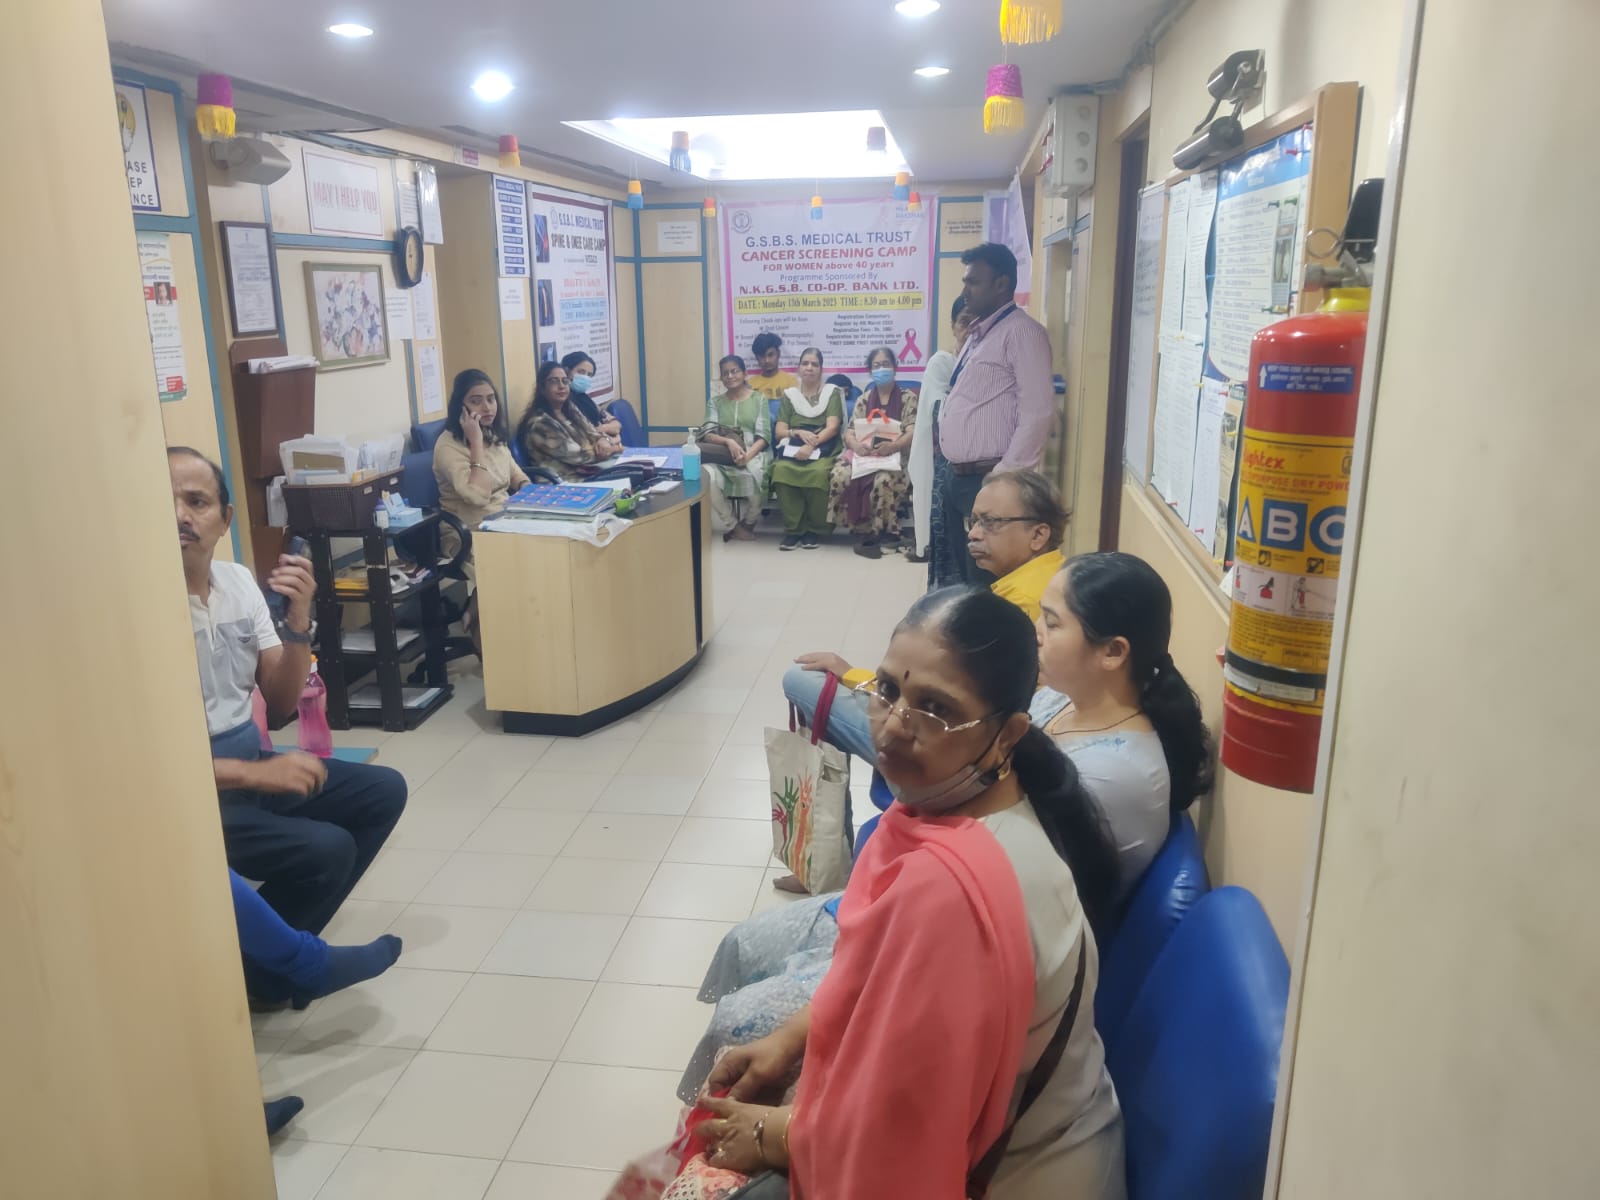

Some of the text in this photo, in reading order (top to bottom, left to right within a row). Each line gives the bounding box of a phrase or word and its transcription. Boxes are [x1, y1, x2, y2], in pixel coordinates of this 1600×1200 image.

[745, 231, 912, 248] G.S.B.S. MEDICAL TRUST
[741, 245, 917, 262] CANCER SCREENING CAMP
[763, 261, 895, 272] FOR WOMEN above 40 years
[780, 272, 878, 283] Programme Sponsored By
[739, 280, 919, 295] N.K.G.S.B. CO-OP. BANK LTD.
[762, 298, 786, 311] Monday
[802, 297, 822, 307] March
[889, 297, 896, 305] to
[911, 297, 922, 307] pm
[1238, 504, 1253, 539] A
[1267, 508, 1298, 542] B
